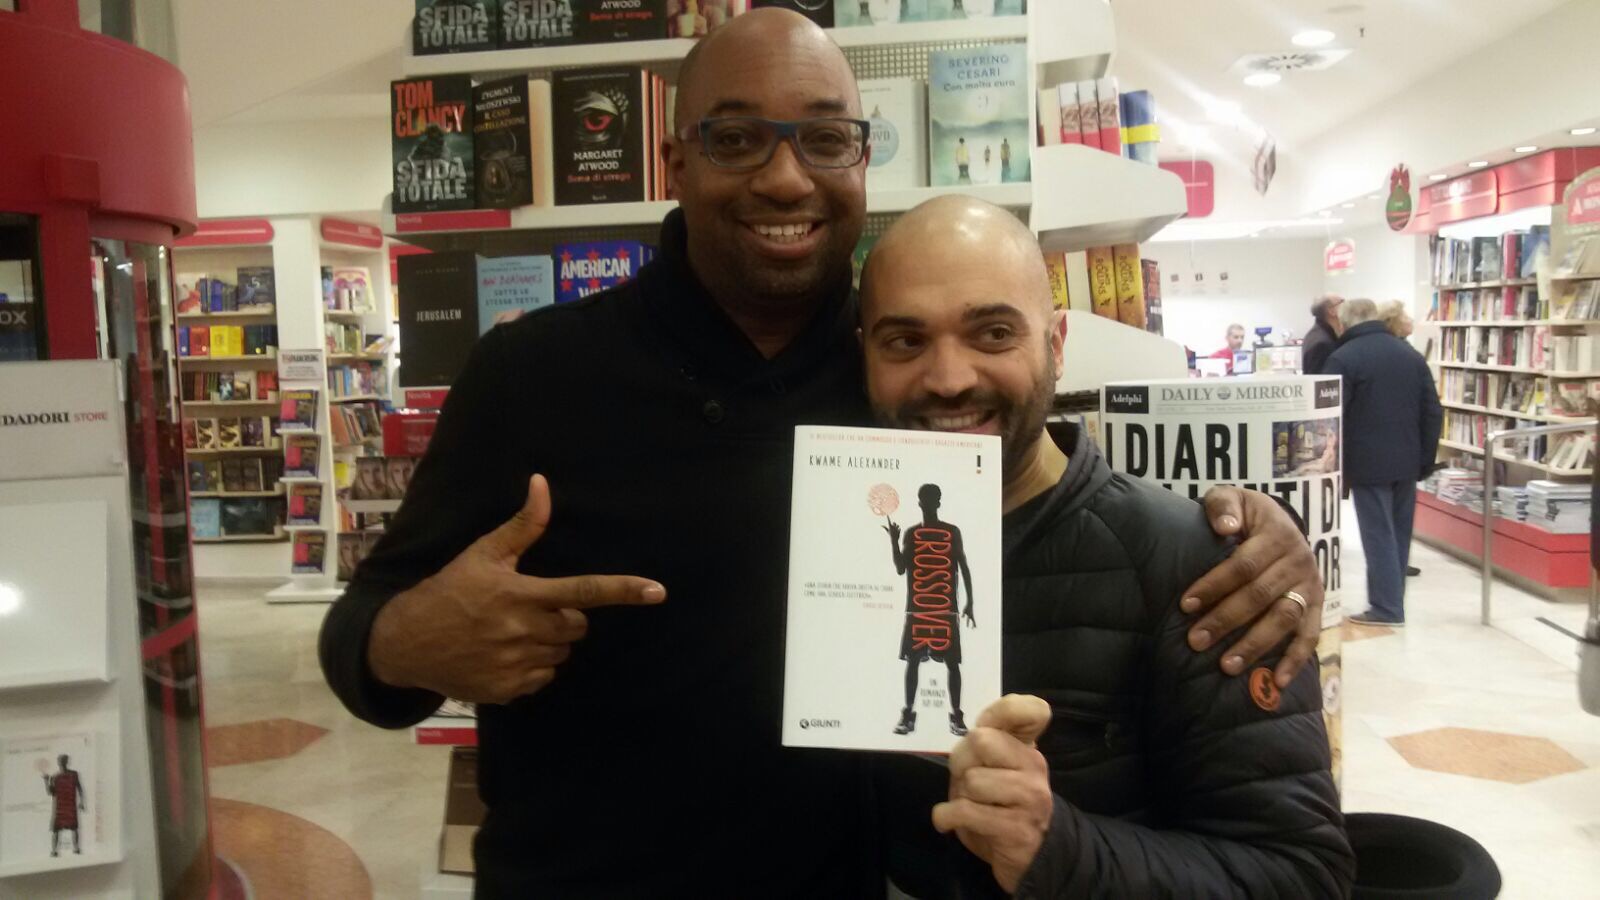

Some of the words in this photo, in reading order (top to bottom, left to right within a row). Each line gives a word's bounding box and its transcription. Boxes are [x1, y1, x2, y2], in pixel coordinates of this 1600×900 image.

[419, 3, 489, 28] SFIDA
[503, 0, 573, 22] SFIDA
[421, 25, 488, 48] TOTALE
[504, 20, 573, 42] TOTALE
[948, 55, 1009, 68] SEVERINO
[957, 67, 1001, 80] CESARI
[394, 80, 434, 112] TOM
[944, 83, 963, 92] Con
[395, 104, 466, 138] CLANCY
[574, 149, 623, 161] MARGARET
[397, 156, 467, 183] SFIDA
[578, 161, 619, 172] ATWOOD
[400, 174, 467, 203] TOTALE
[560, 257, 631, 280] AMERICAN
[416, 309, 462, 322] JERUSALEM
[1110, 391, 1143, 406] Adelphi
[1161, 386, 1214, 401] DAILY
[1235, 384, 1304, 400] MIRROR
[0, 411, 70, 426] DADORI
[73, 411, 108, 422] STORE
[1125, 422, 1249, 480] DIARI
[809, 454, 842, 467] KWAME
[847, 456, 900, 470] ALEXANDER
[912, 527, 952, 651] CROSSOVER
[810, 719, 841, 728] GIUNTI
